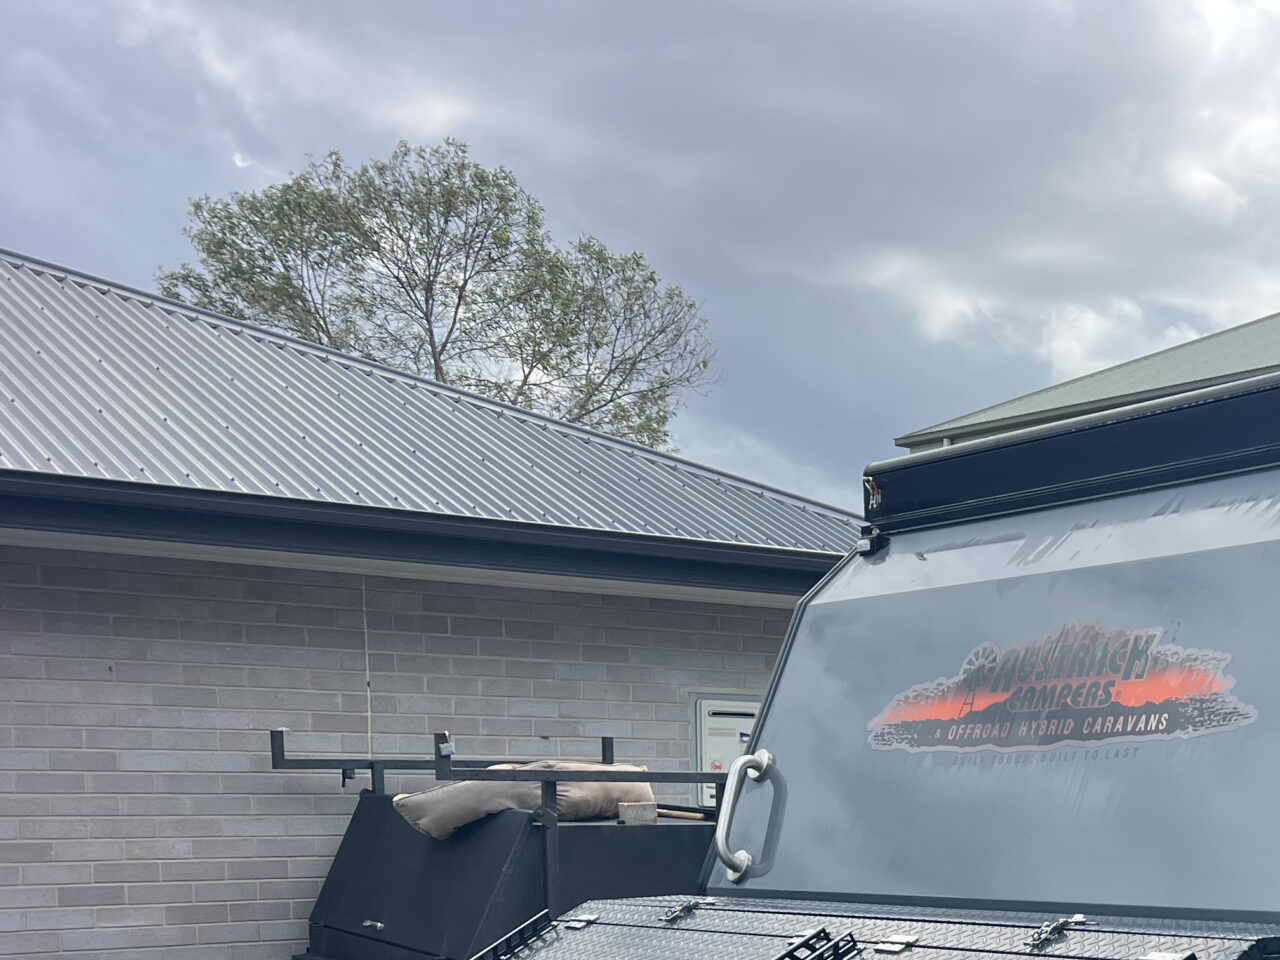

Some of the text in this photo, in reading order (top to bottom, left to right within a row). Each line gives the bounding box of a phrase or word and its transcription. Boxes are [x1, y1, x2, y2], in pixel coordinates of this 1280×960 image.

[988, 627, 1163, 693] AUSTRACK
[1006, 679, 1117, 714] CAMPERS
[947, 721, 1011, 741] OFFROAD
[1018, 717, 1075, 738] HYBRID
[1082, 713, 1169, 733] CARAVANS
[1084, 750, 1098, 761] TO
[1105, 747, 1140, 760] LAST
